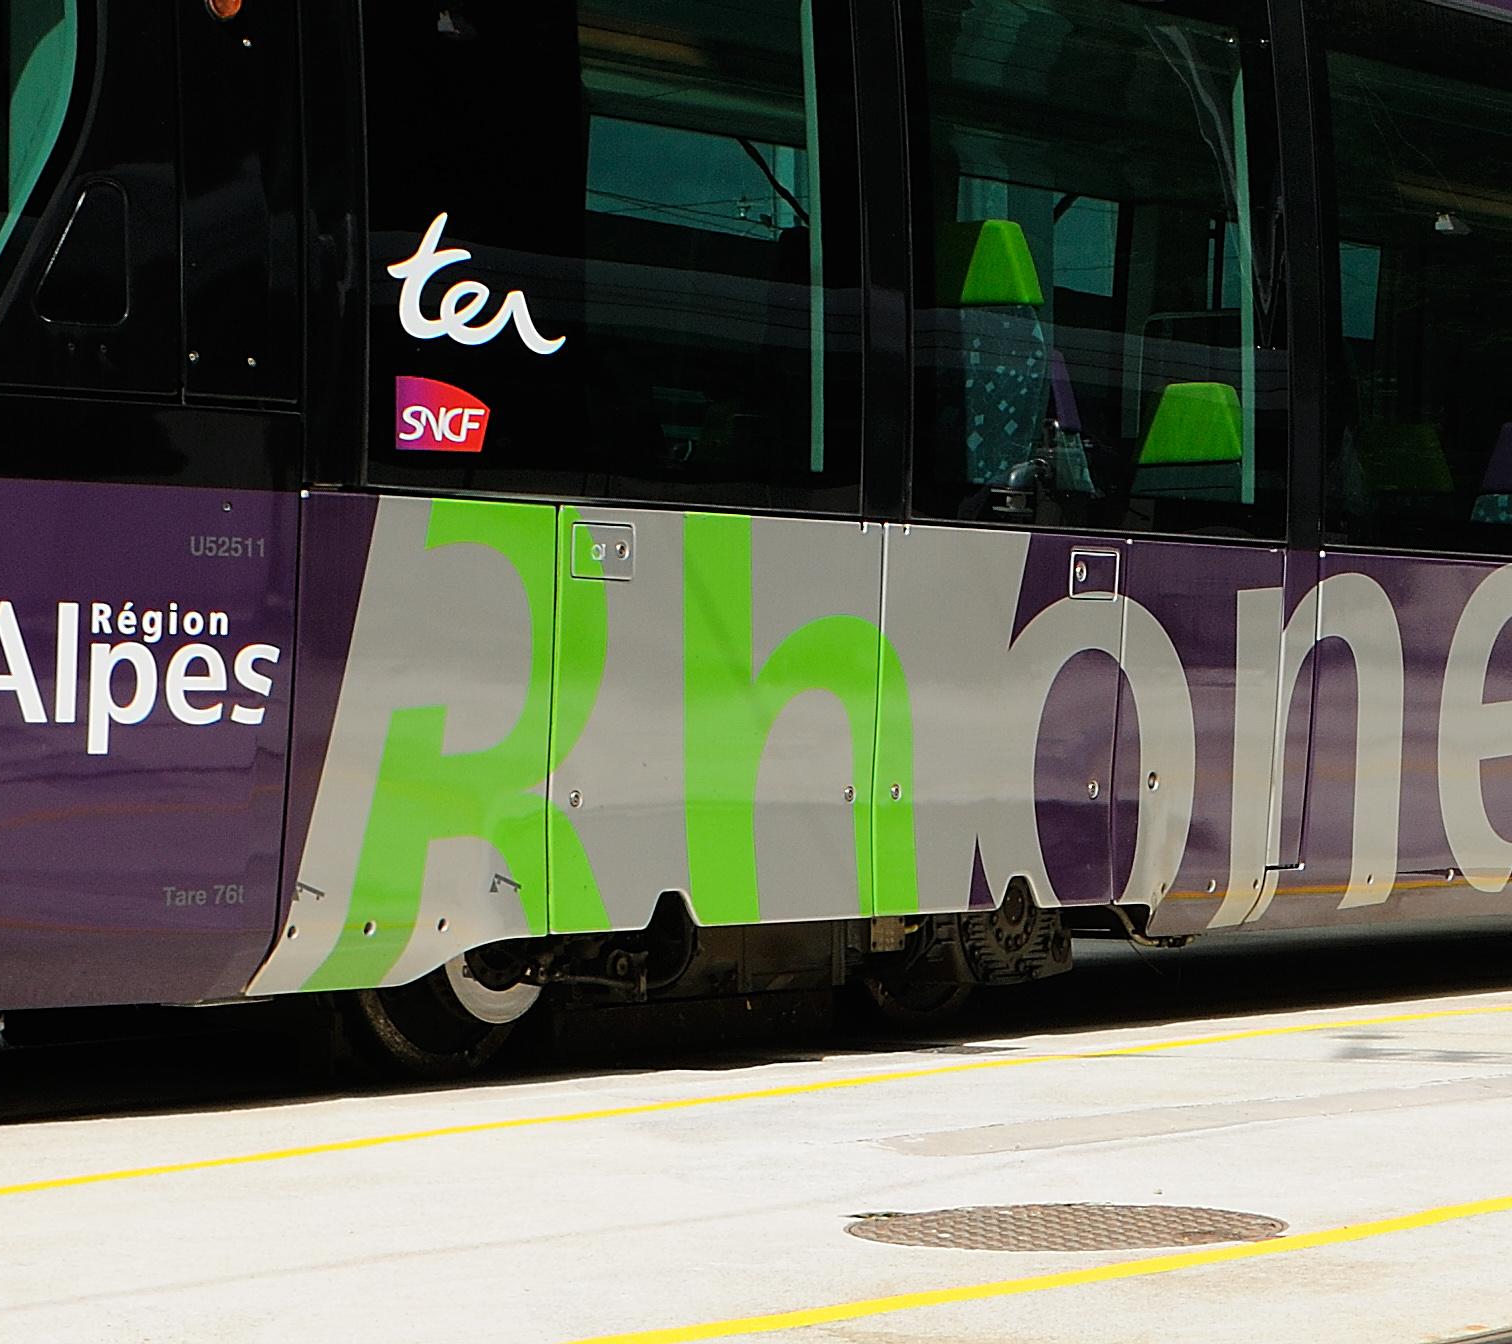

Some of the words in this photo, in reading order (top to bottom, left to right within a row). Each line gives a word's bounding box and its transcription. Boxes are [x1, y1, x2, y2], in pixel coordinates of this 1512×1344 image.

[387, 211, 566, 355] ter
[399, 405, 487, 444] SNCF
[190, 536, 265, 557] U52511
[91, 603, 230, 644] Région
[163, 886, 207, 906] Tare
[213, 884, 245, 905] 76t
